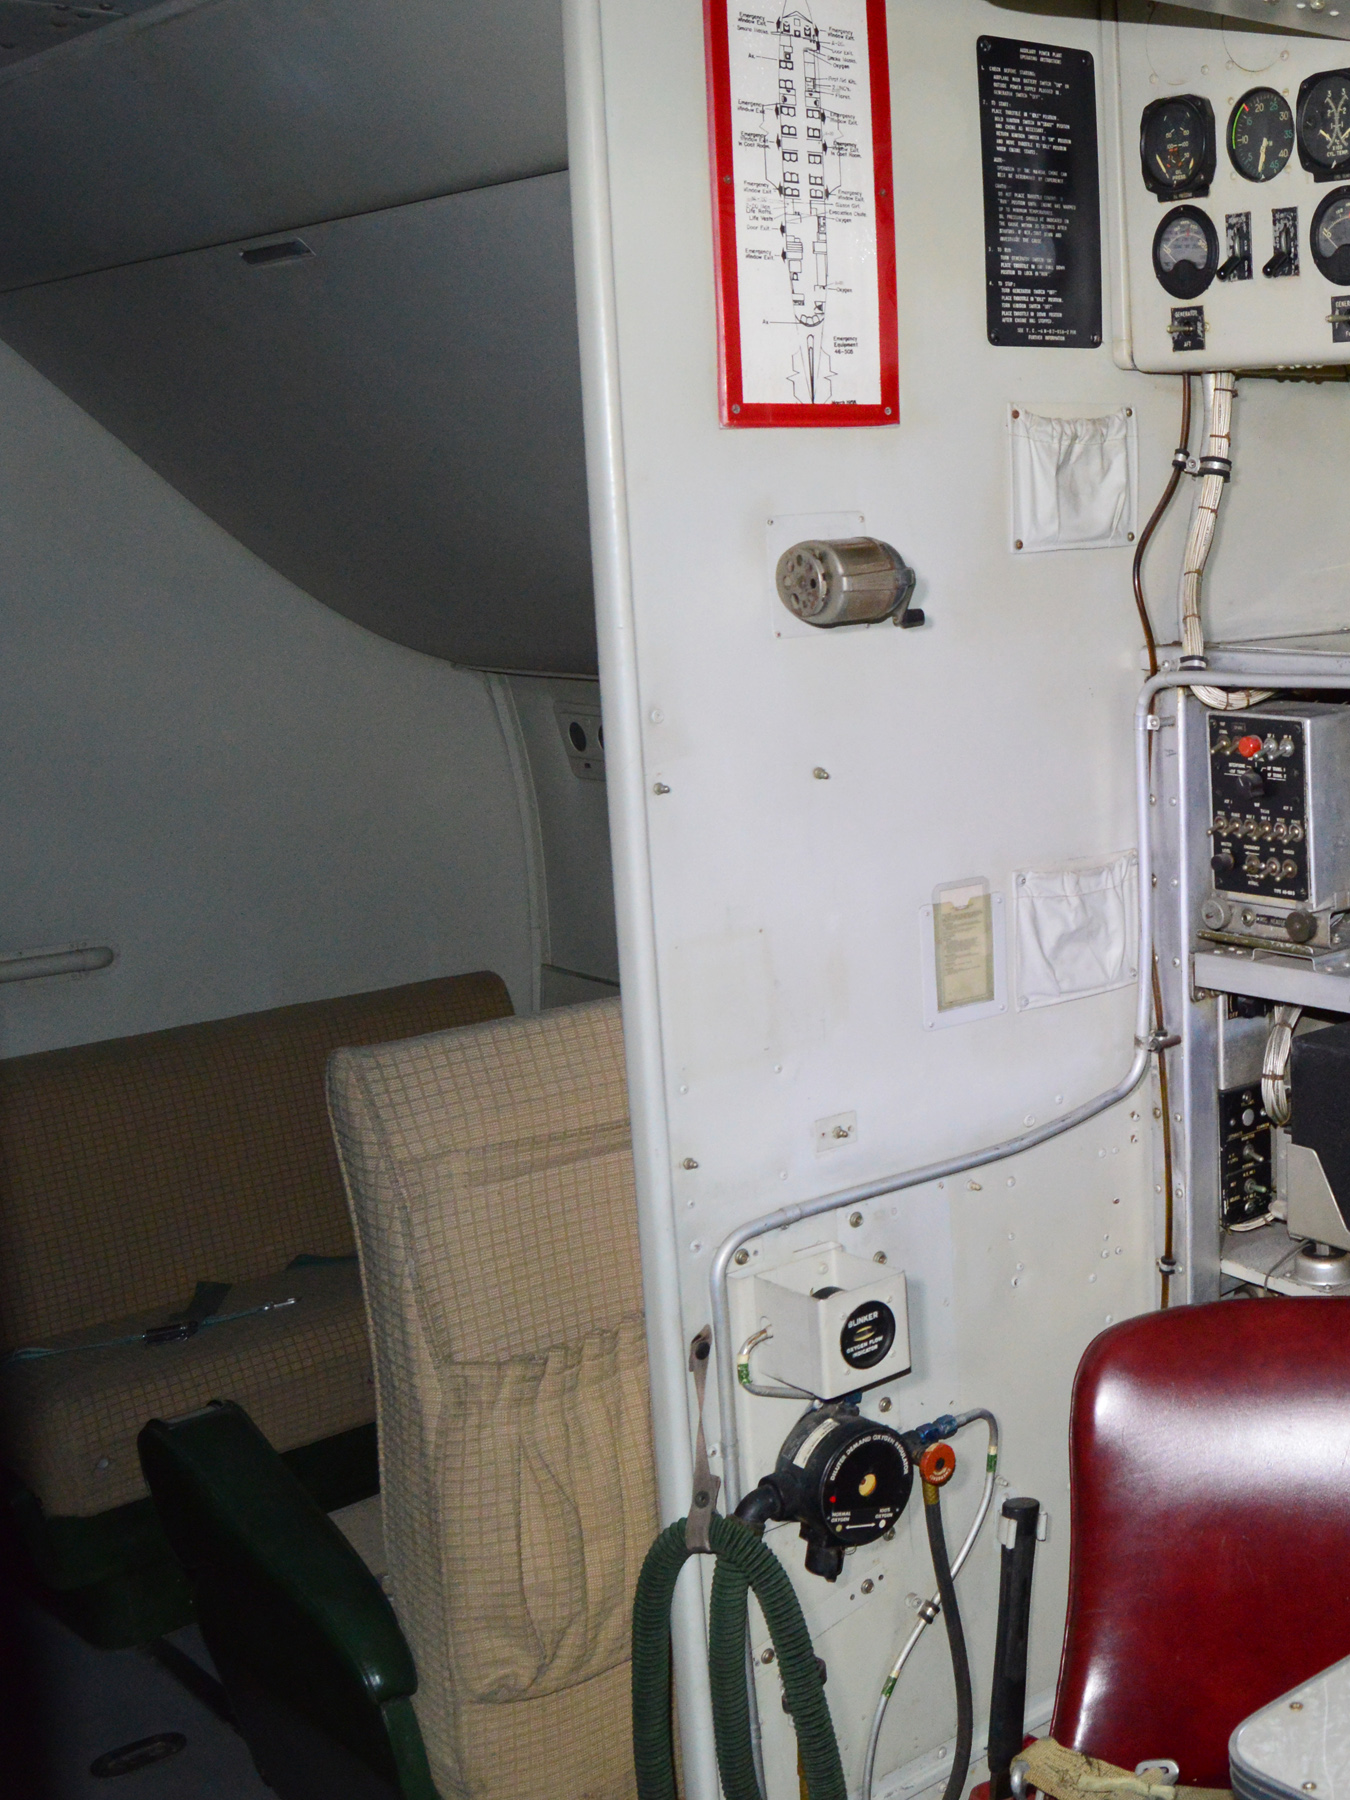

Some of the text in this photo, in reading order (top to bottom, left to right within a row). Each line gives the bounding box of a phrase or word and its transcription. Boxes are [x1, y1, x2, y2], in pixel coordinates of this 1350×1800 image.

[1255, 103, 1264, 113] 20
[1270, 102, 1279, 111] 25
[1279, 111, 1289, 120] 30
[1284, 130, 1293, 139] 35
[1278, 148, 1289, 158] 40
[1270, 160, 1280, 169] 45
[1175, 310, 1198, 318] GENERATOR
[848, 1311, 879, 1328] BLINKER
[846, 1335, 883, 1354] OXYGEN FLOW
[852, 1344, 878, 1358] INDICATOR
[830, 1455, 847, 1481] DILUTER
[846, 1436, 872, 1455] DEMAND
[873, 1435, 895, 1445] OXYGEN
[895, 1441, 909, 1475] REGULATOR
